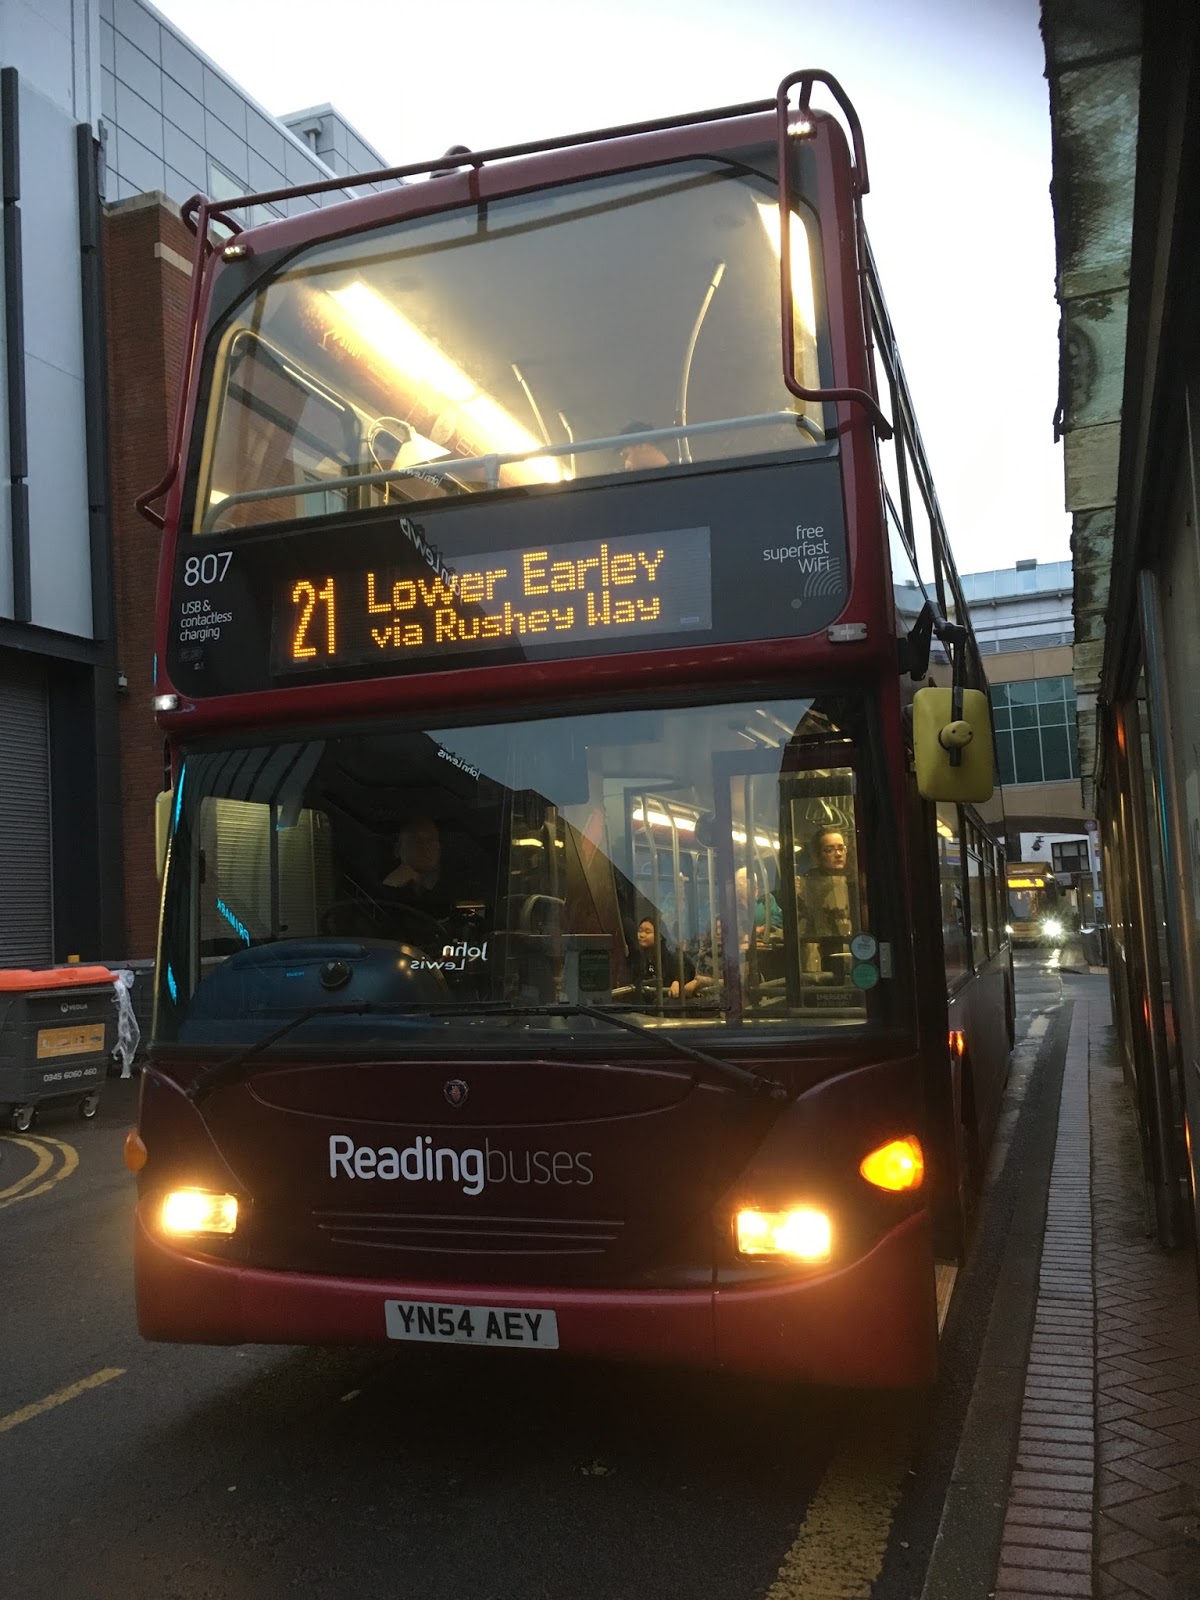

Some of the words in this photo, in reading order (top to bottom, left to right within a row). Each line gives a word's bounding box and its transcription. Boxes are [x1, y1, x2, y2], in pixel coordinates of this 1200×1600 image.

[796, 525, 824, 540] free
[763, 540, 830, 563] superfast
[184, 551, 233, 587] 807
[798, 556, 830, 574] WiFi
[367, 569, 507, 614] Lower
[522, 544, 664, 596] Earley
[181, 600, 202, 615] USB
[202, 599, 212, 612] &
[291, 577, 336, 658] 21
[180, 612, 233, 628] contactless
[371, 618, 423, 648] via
[435, 602, 574, 643] Rushey
[587, 591, 660, 627] Way
[180, 626, 221, 642] charging
[397, 1304, 475, 1338] YN54
[486, 1312, 543, 1342] AEY
